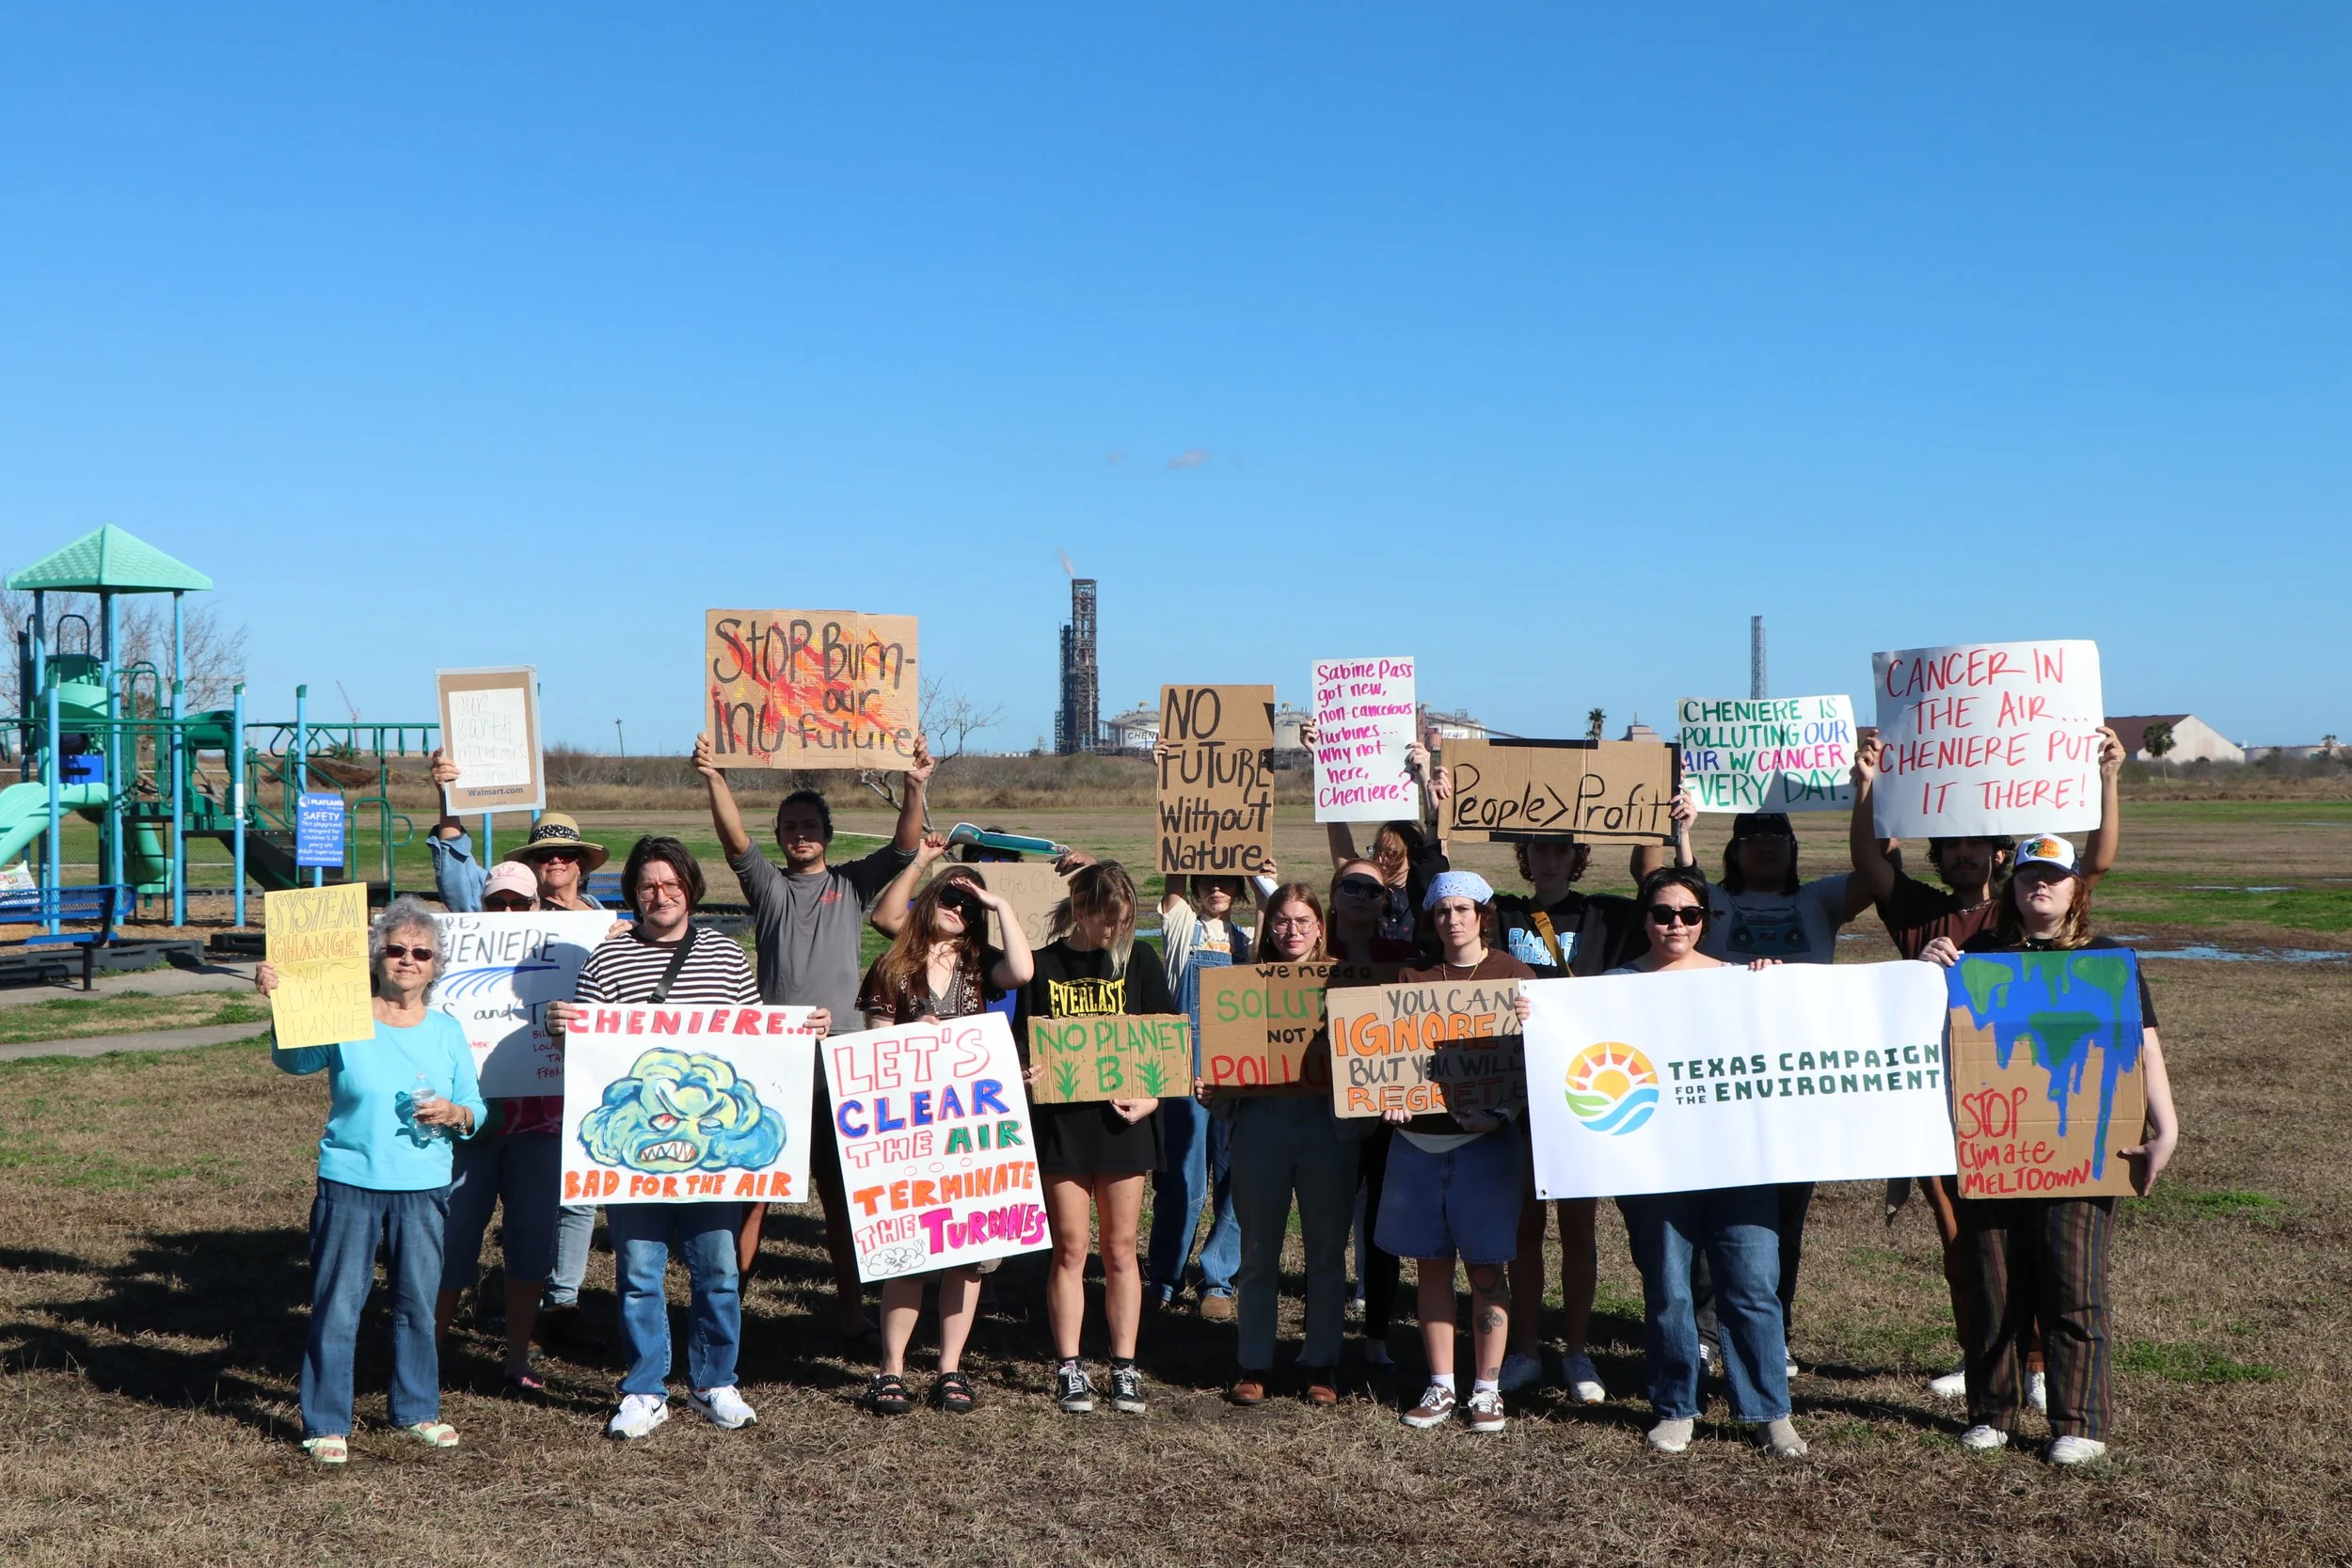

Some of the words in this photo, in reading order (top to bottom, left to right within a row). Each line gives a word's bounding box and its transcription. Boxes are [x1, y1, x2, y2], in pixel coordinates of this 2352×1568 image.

[1318, 662, 1375, 686] Sabine
[1379, 659, 1413, 679] Pass
[1886, 648, 2026, 697] CANCER
[2033, 648, 2063, 684] IN
[1318, 684, 1346, 707] got
[1351, 683, 1387, 696] new,
[1684, 700, 1803, 722] CHENIERE
[1819, 697, 1837, 719] IS
[1165, 689, 1221, 739] NO
[1908, 696, 1980, 735] THE
[799, 712, 914, 758] future
[1128, 730, 1156, 740] CHEN
[1356, 740, 1389, 757] not
[1682, 723, 1800, 749] POLLUTING
[1804, 720, 1850, 745] OUR
[1684, 751, 1720, 772] AIR
[1757, 744, 1847, 772] CANCER
[1878, 732, 2031, 775] CHENIERE
[2048, 730, 2101, 763] PUT
[1162, 741, 1273, 804] FUTURE
[1319, 771, 1415, 808] Cheniere?
[1327, 767, 1369, 784] here,
[1784, 768, 1849, 803] DAY.
[468, 787, 523, 797] Walmart.com
[1923, 782, 1958, 815] IT
[1975, 773, 2086, 810] THERE!
[303, 812, 340, 821] SAFETY
[267, 890, 360, 937] SYSTEM
[271, 931, 359, 964] CHANGE
[276, 981, 369, 1015] CLIMATE
[1048, 978, 1125, 1019] EVERLAST
[1216, 988, 1326, 1022] SOLUT
[1387, 989, 1440, 1019] YOU
[1447, 988, 1515, 1013] CAN
[1036, 1023, 1088, 1055] NO
[1094, 1021, 1190, 1054] PLANET
[1266, 1028, 1306, 1043] NOT
[1334, 1012, 1498, 1056] IGNORE
[834, 1027, 990, 1097] LET'S
[1094, 1055, 1124, 1093] B
[1350, 1056, 1406, 1086] BUT
[1459, 1053, 1525, 1077] WILL
[1667, 1053, 1767, 1081] TEXAS
[1779, 1044, 1940, 1071] CAMPAIGN
[1347, 1077, 1503, 1113] REGRET
[1675, 1085, 1707, 1095] FOR
[1675, 1095, 1707, 1105] THE
[1714, 1069, 1940, 1102] ENVIRONMENT
[836, 1079, 1010, 1140] CLEAR
[1959, 1086, 2027, 1139] STOP
[846, 1131, 933, 1168] THE
[944, 1120, 1025, 1154] AIR
[564, 1170, 620, 1199] BAD
[629, 1175, 679, 1197] FOR
[679, 1175, 726, 1195] THE
[735, 1171, 792, 1197] AIR
[853, 1162, 1035, 1217] TERMINATE
[853, 1214, 916, 1255] THE
